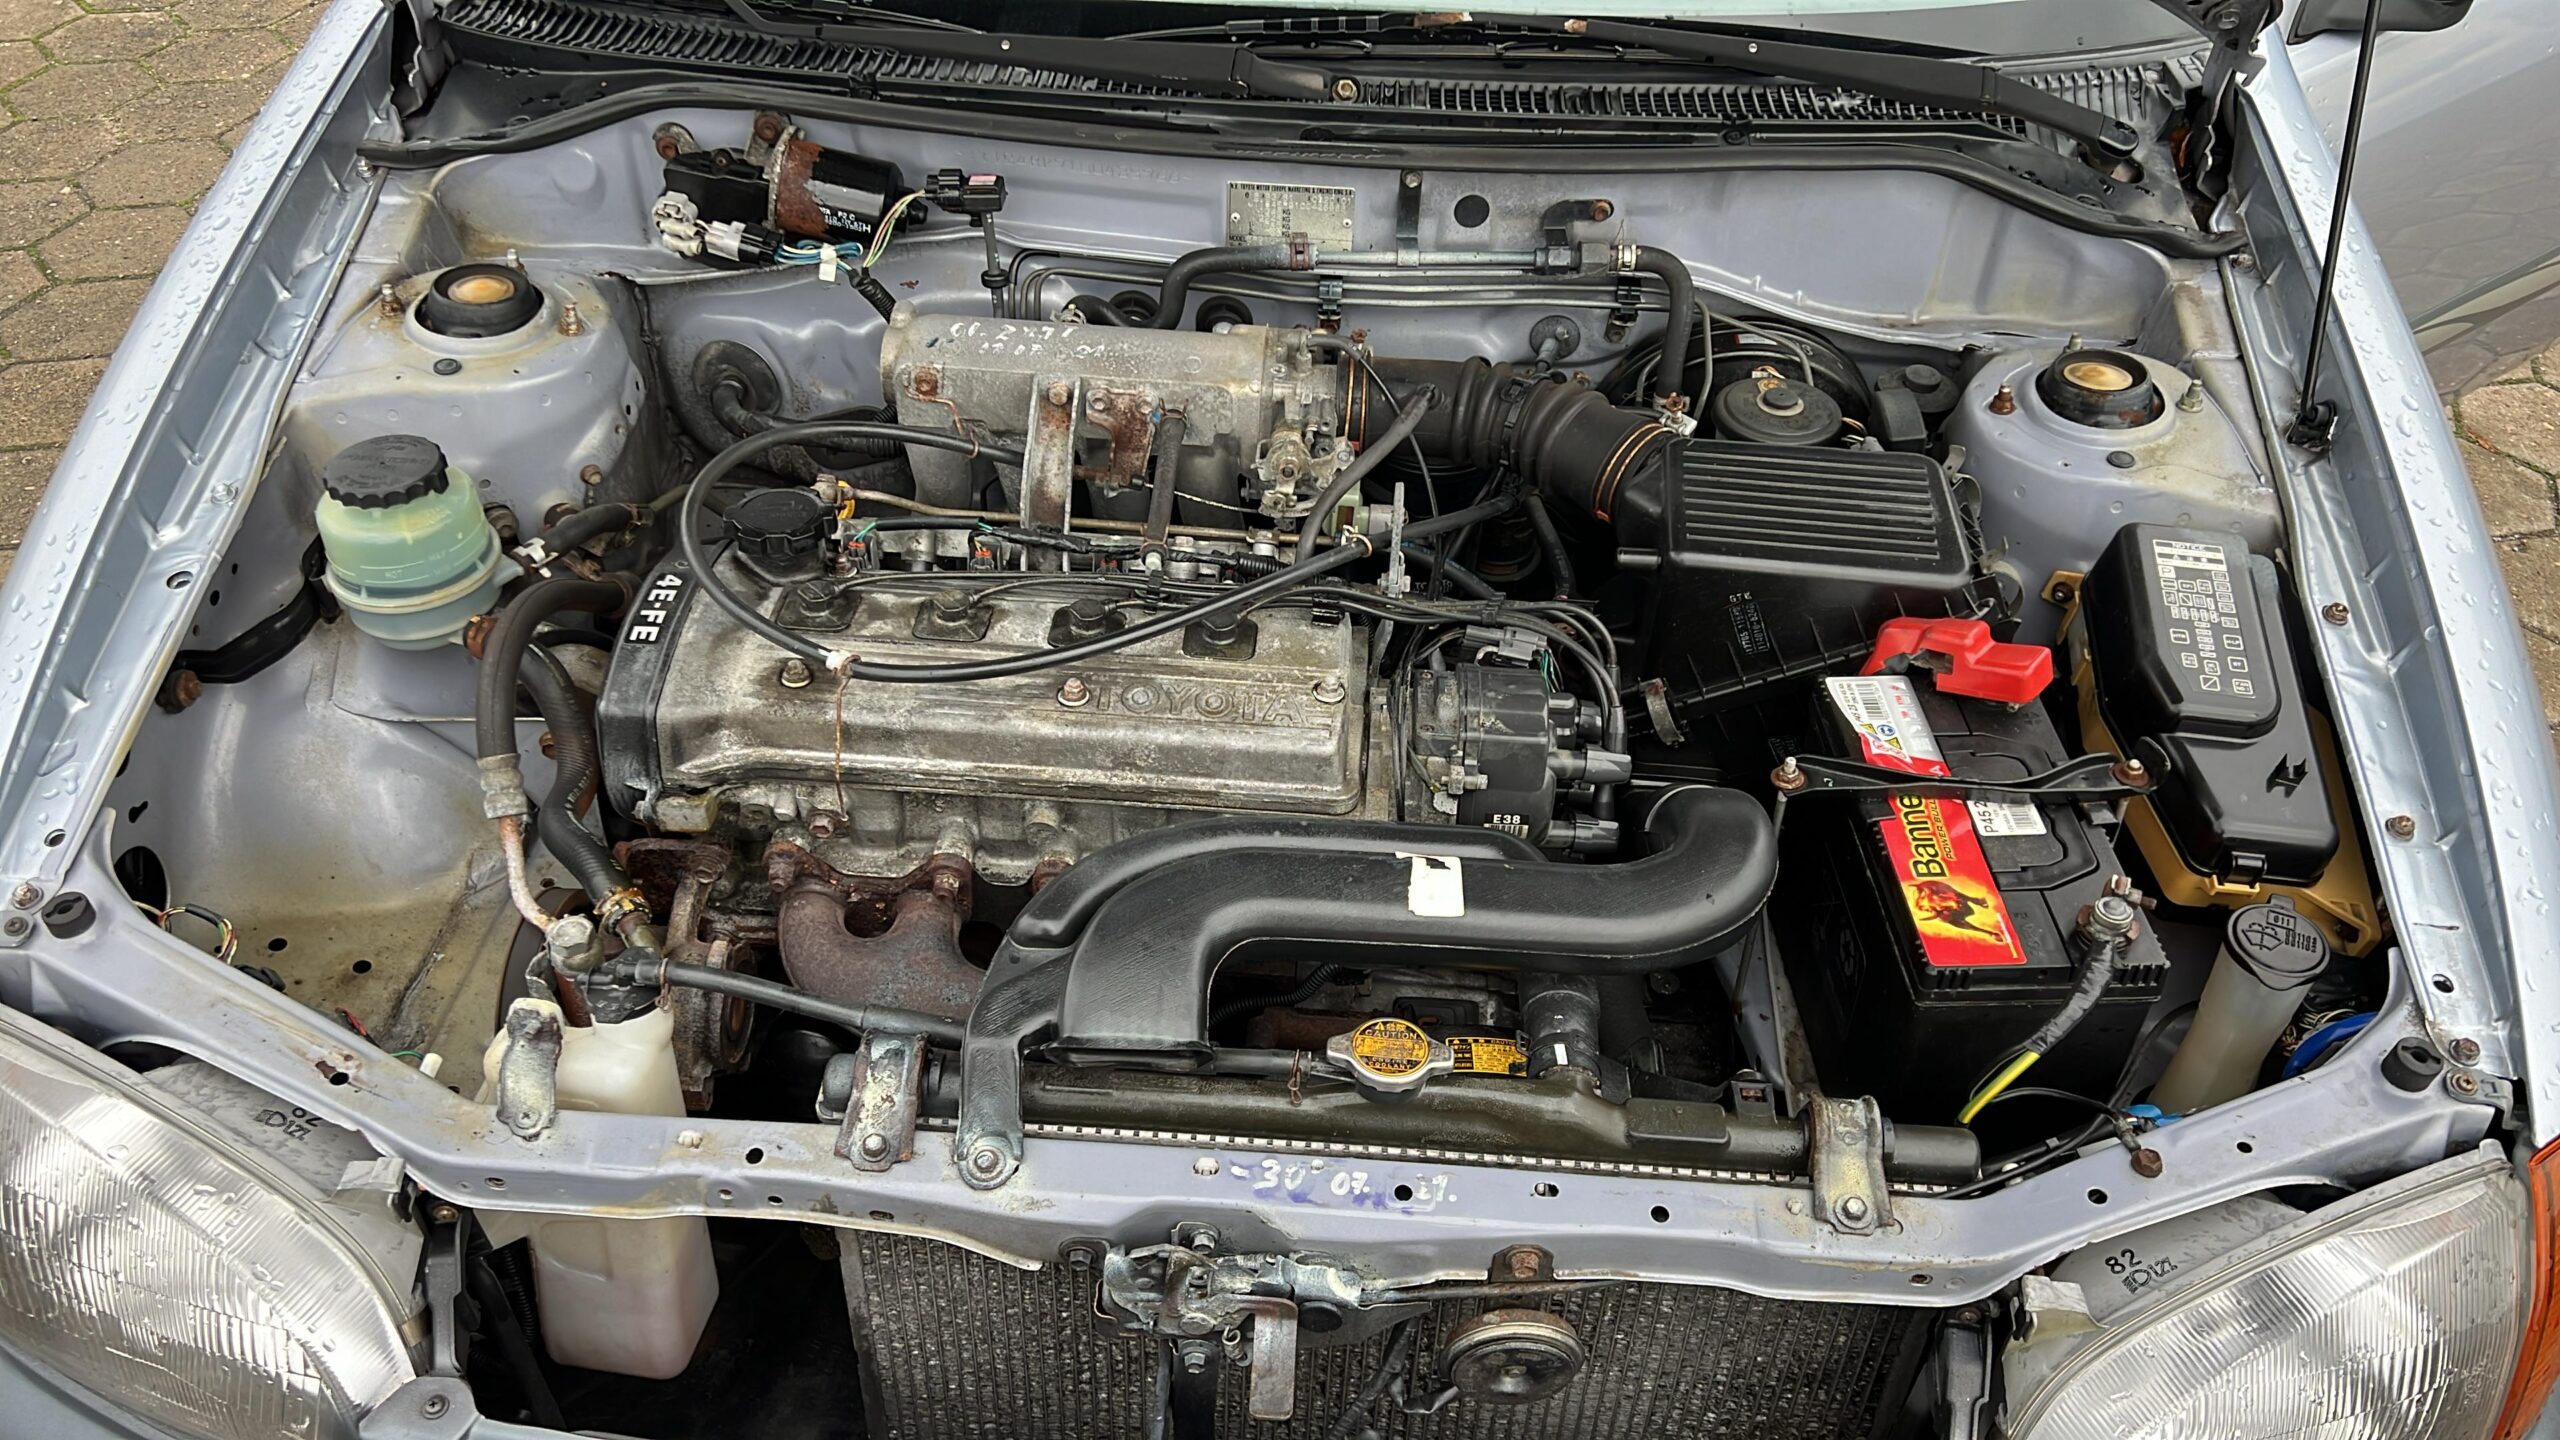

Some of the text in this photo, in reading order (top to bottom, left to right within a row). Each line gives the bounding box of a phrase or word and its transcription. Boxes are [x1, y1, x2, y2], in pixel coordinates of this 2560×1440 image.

[629, 574, 683, 642] 4E-FE
[1093, 682, 1310, 726] TOYOTA
[1493, 814, 1521, 824] E38
[1898, 793, 1948, 878] Banne
[1929, 800, 1954, 859] POWER BULL
[1979, 811, 1999, 833] P45
[1365, 1029, 1417, 1039] CAUTION
[2104, 1248, 2142, 1275] 82
